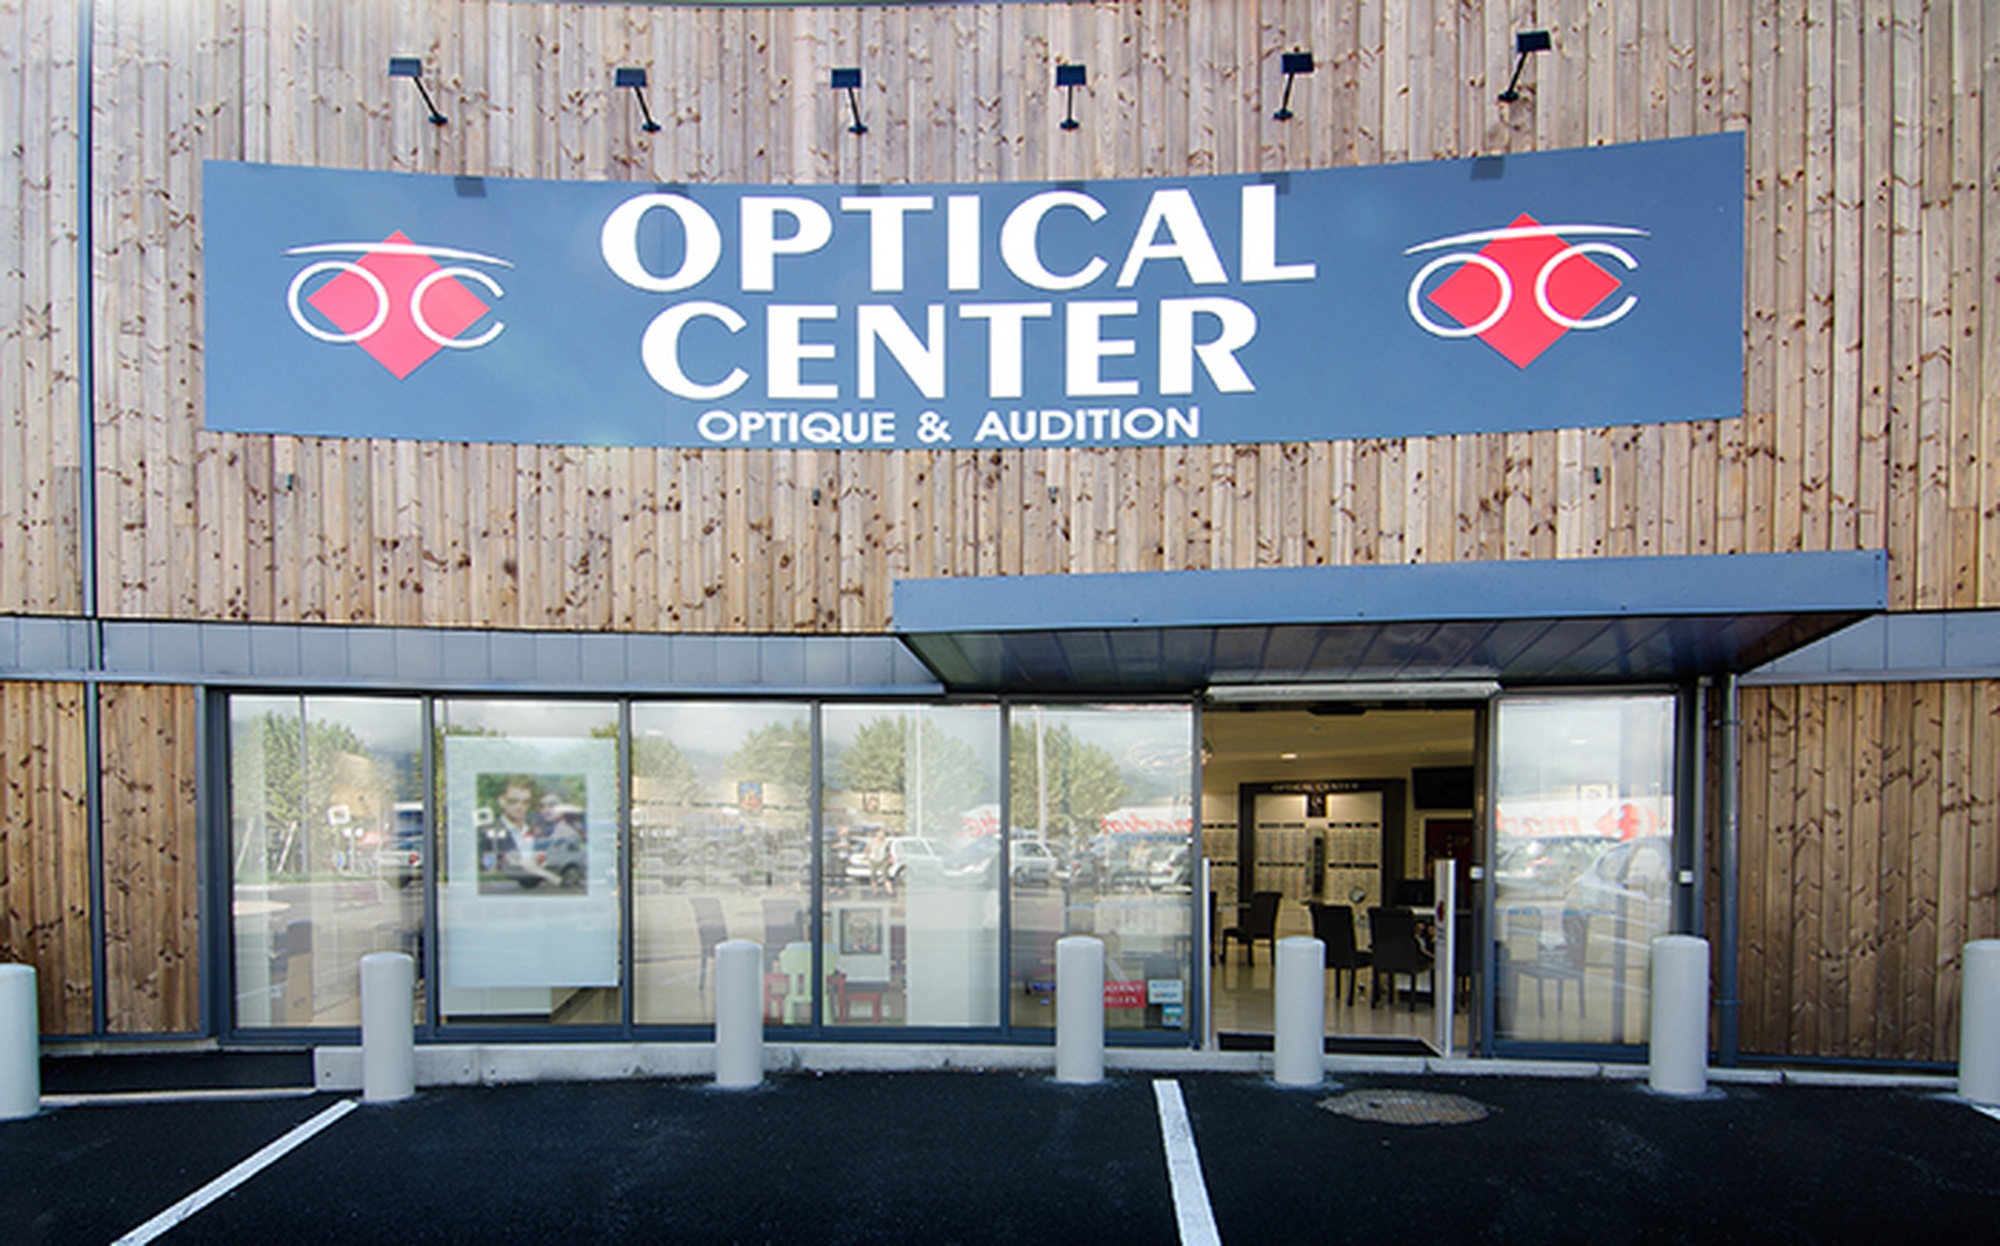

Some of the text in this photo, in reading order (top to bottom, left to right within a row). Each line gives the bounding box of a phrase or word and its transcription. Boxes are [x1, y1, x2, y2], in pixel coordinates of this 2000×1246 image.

[600, 184, 1316, 292] OPTICAL
[641, 296, 1257, 400] CENTER
[697, 406, 1200, 444] OPTIQUE & AUDITION
